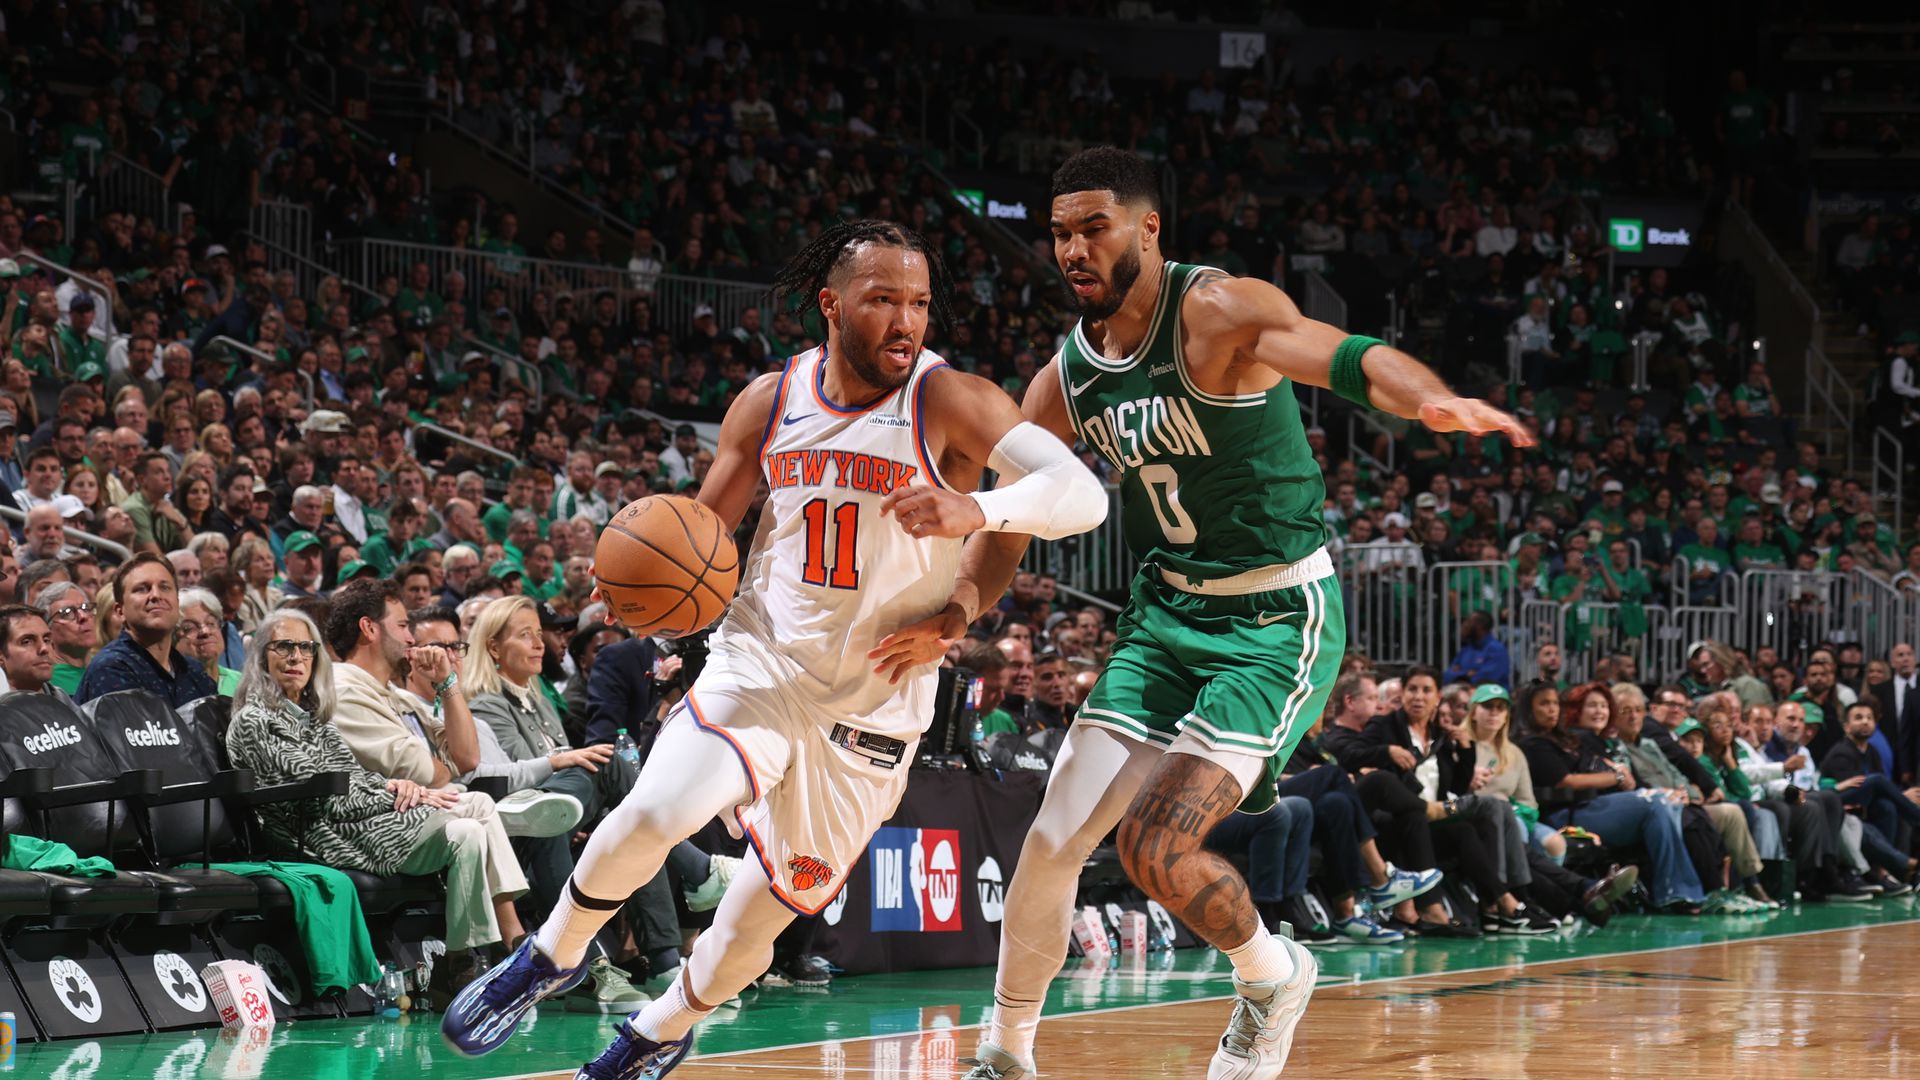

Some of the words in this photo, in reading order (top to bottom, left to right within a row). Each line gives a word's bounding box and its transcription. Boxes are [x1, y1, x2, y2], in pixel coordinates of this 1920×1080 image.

[1230, 37, 1258, 63] 16
[987, 200, 1027, 219] Bank
[1612, 224, 1640, 246] TD
[1647, 227, 1690, 245] Bank
[1148, 362, 1175, 378] Amica
[1083, 395, 1212, 475] BOSTON
[767, 450, 831, 490] NEW
[832, 451, 918, 496] YORK
[1139, 464, 1198, 544] 0
[802, 498, 859, 591] 11
[23, 722, 82, 755] @celtics
[124, 720, 180, 747] @celtics
[875, 848, 902, 909] NBA
